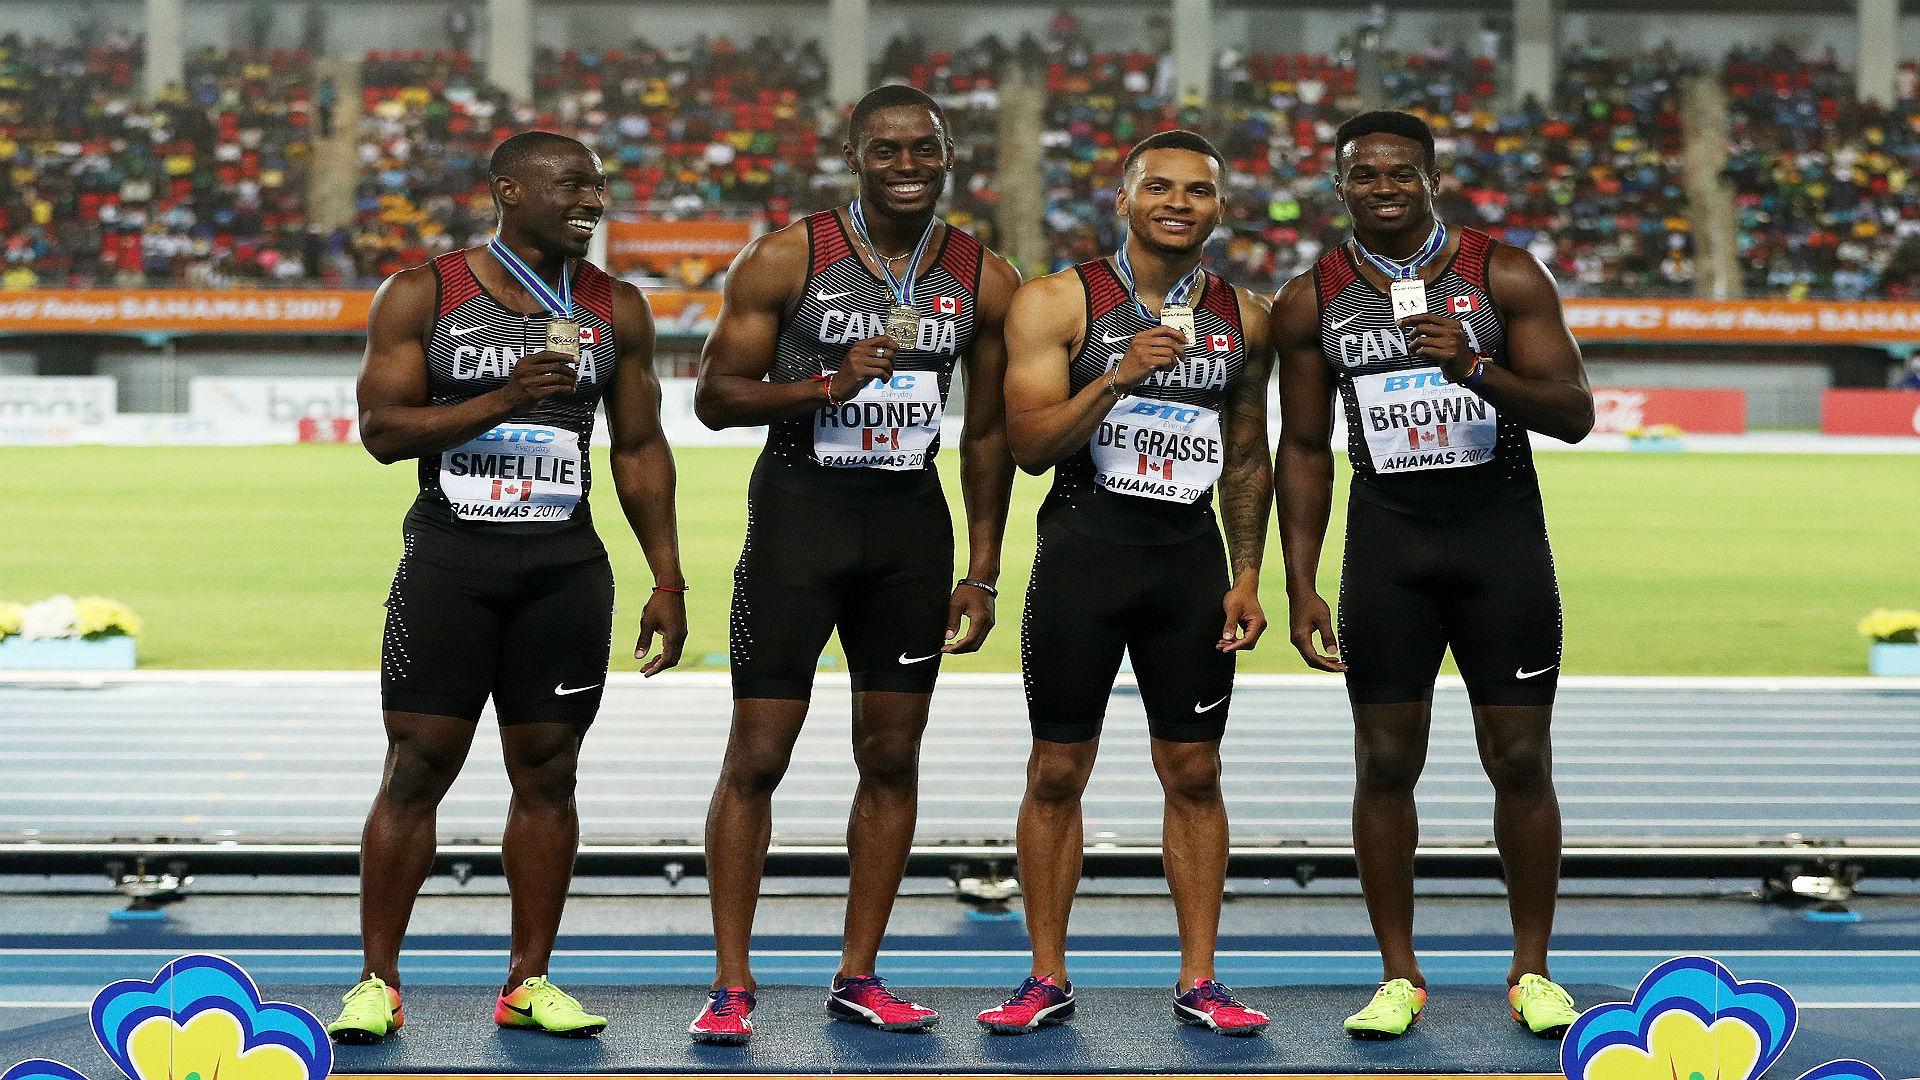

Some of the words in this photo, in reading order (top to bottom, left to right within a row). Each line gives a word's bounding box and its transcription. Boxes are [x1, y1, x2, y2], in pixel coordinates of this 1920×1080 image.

[818, 309, 956, 355] CANDA
[1340, 321, 1481, 368] CANA
[452, 346, 598, 384] CANA
[1384, 371, 1449, 392] BTC
[1422, 387, 1457, 396] Everyday
[880, 390, 913, 399] Everyday
[820, 402, 937, 428] RODNEY
[1130, 402, 1200, 424] BTC
[1369, 396, 1487, 432] BROWN
[476, 428, 555, 443] BTC
[1097, 422, 1129, 449] DE
[1133, 429, 1219, 464] GRASSE
[515, 444, 550, 454] Everyday
[822, 454, 906, 467] BAHAMAS
[909, 453, 925, 466] 20
[1381, 452, 1456, 470] AHAMAS
[1460, 448, 1489, 463] 2017
[450, 452, 575, 484] SMELLIE
[1100, 473, 1178, 497] BAHAMAS
[1180, 487, 1204, 501] 20
[450, 502, 532, 518] BAHAMAS
[533, 505, 566, 518] 2017
